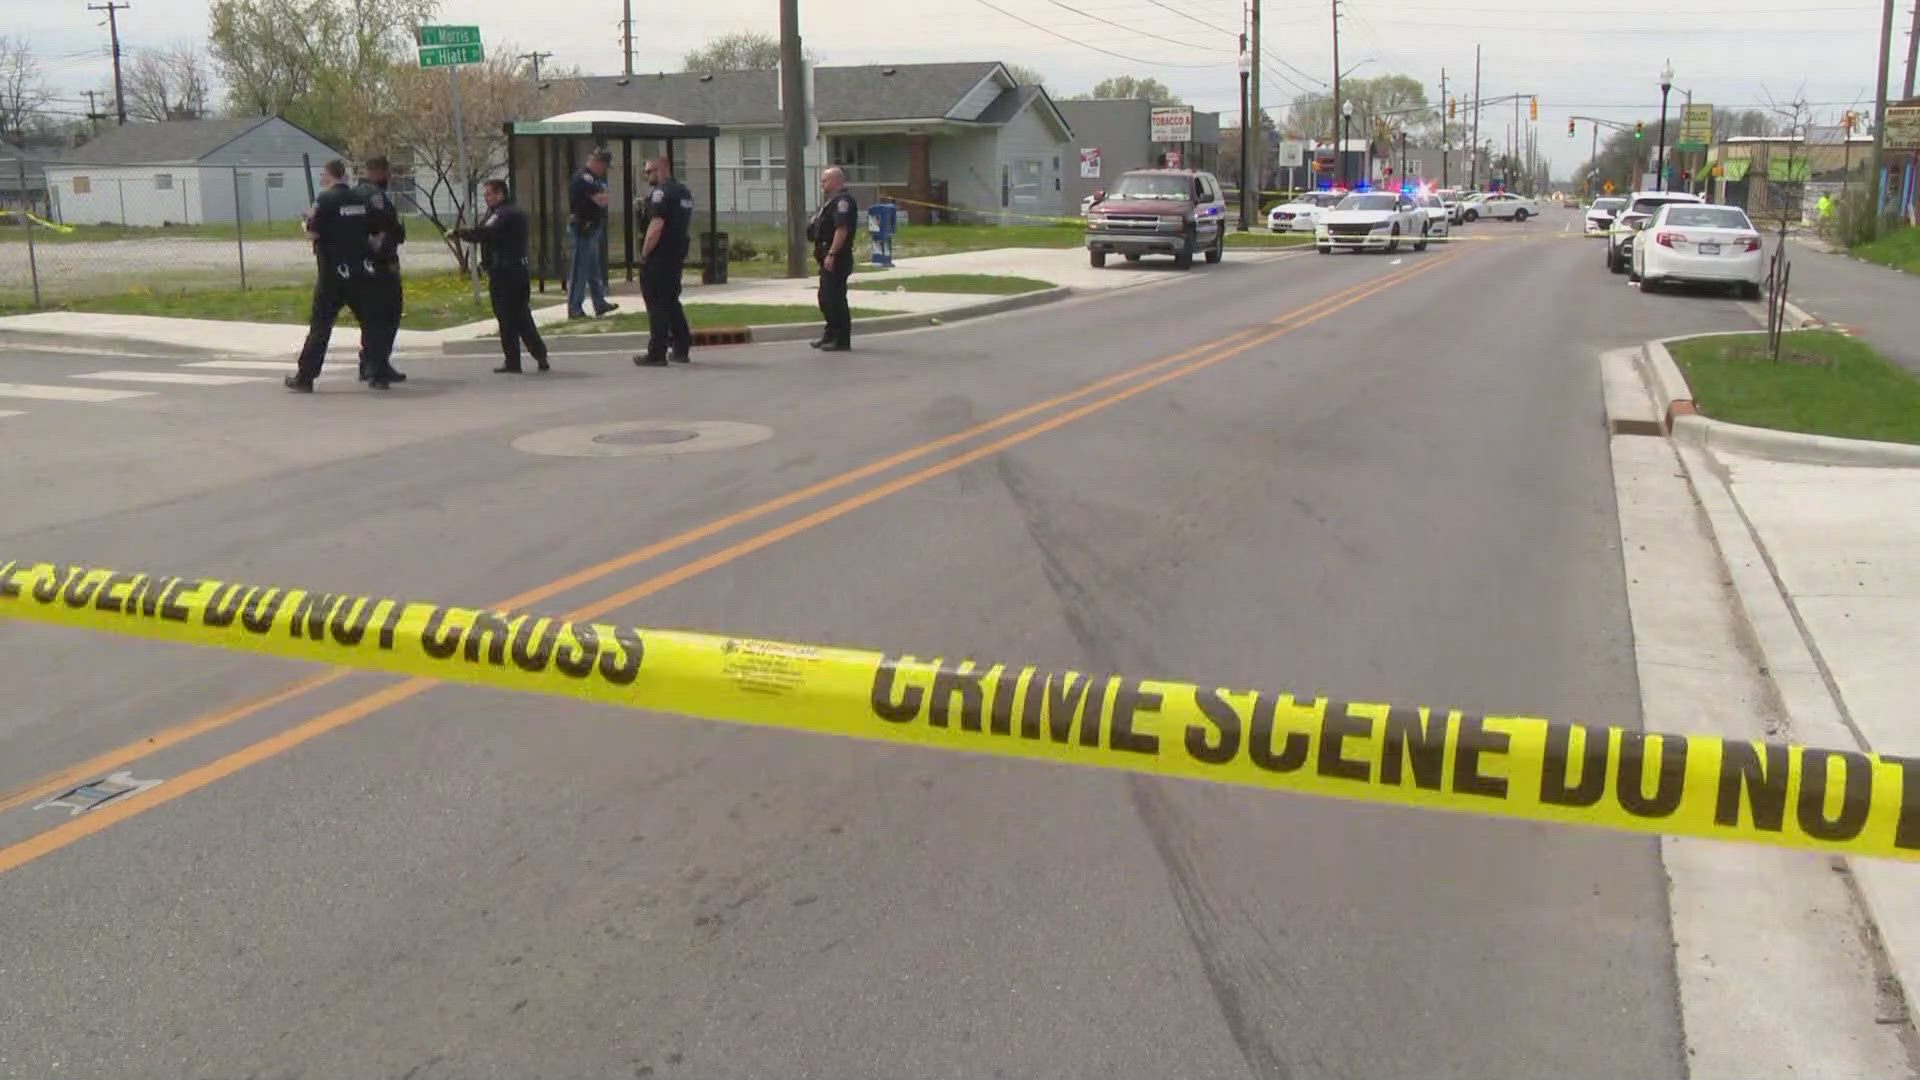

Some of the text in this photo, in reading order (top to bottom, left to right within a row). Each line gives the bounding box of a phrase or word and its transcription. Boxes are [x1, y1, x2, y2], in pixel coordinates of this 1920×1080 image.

[438, 28, 470, 42] Morris
[438, 47, 468, 65] Hiatt
[1152, 116, 1184, 127] TOBACCO
[422, 606, 644, 685] CROSS
[872, 659, 1163, 754] CRIME
[1184, 686, 1512, 799] SCENE
[1539, 724, 1688, 818] DO
